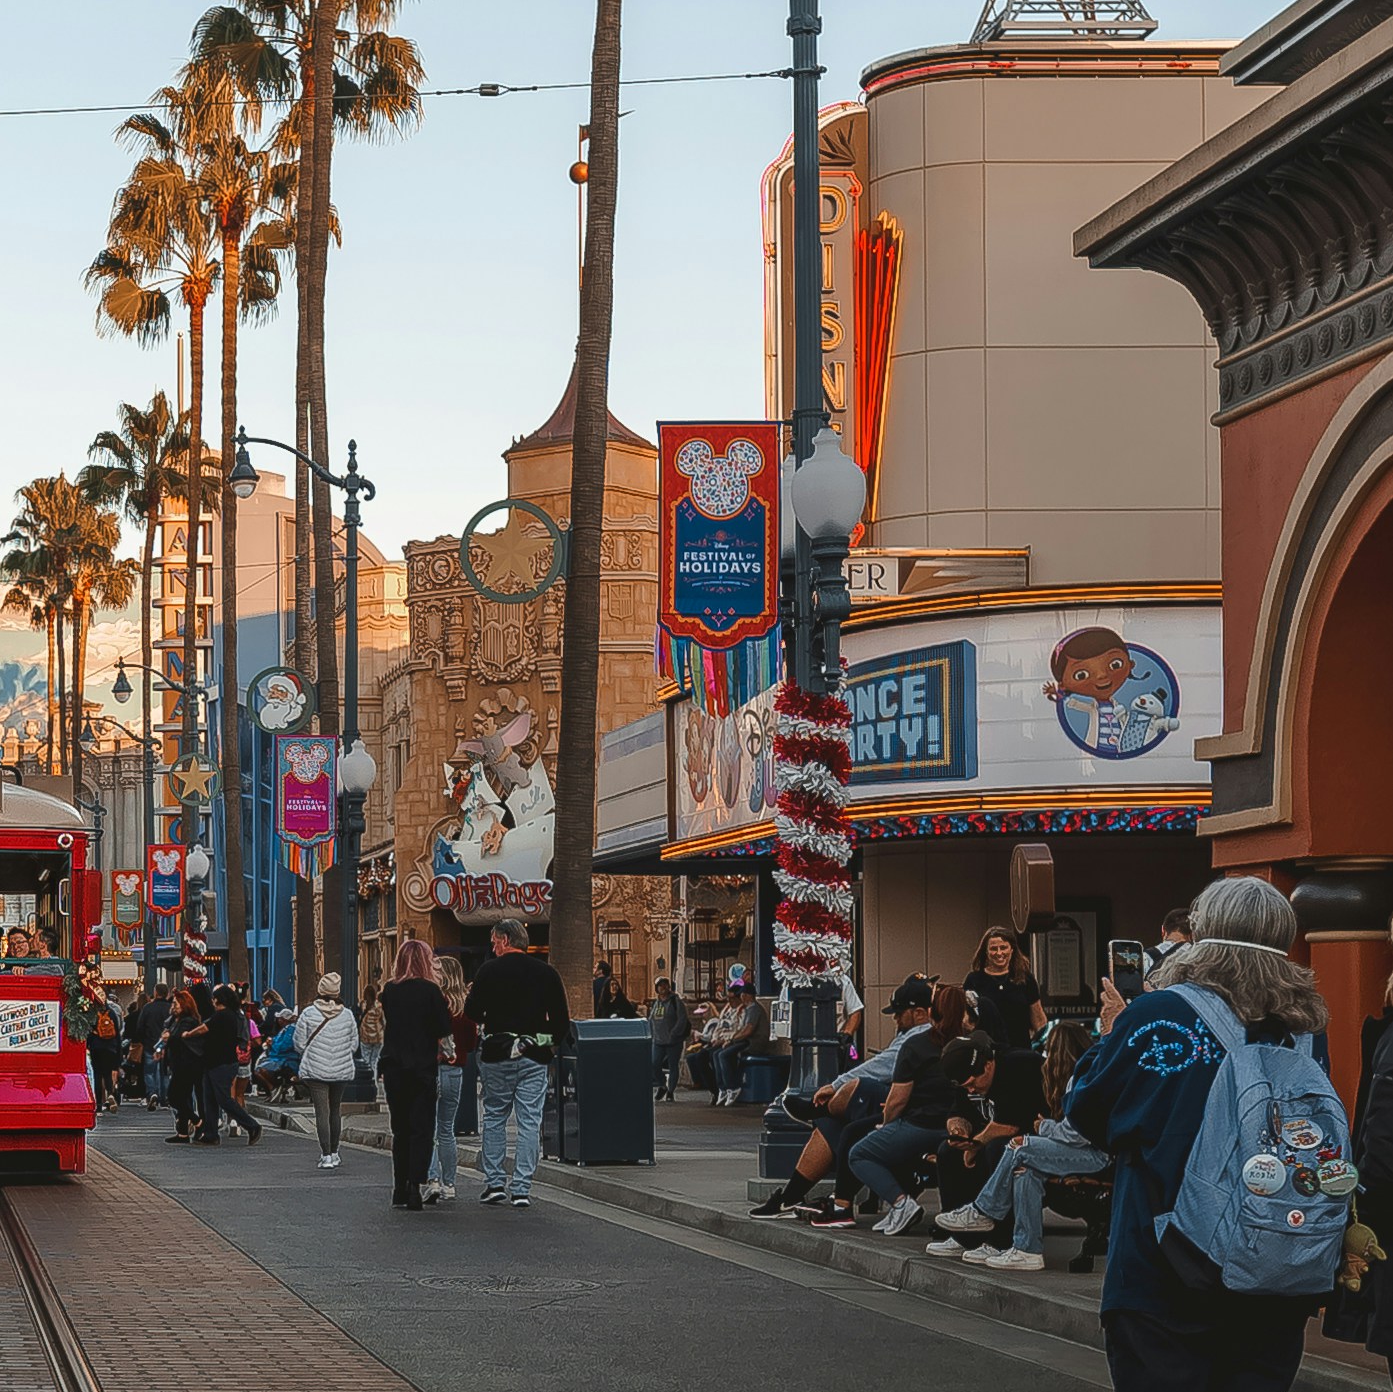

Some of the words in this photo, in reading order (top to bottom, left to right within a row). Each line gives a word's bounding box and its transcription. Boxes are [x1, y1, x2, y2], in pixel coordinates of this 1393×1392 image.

[820, 185, 848, 435] DISN
[683, 551, 745, 561] FESTIVAL
[679, 562, 761, 573] HOLIDAYS
[488, 872, 553, 916] Page
[28, 1014, 49, 1028] CIRCLE
